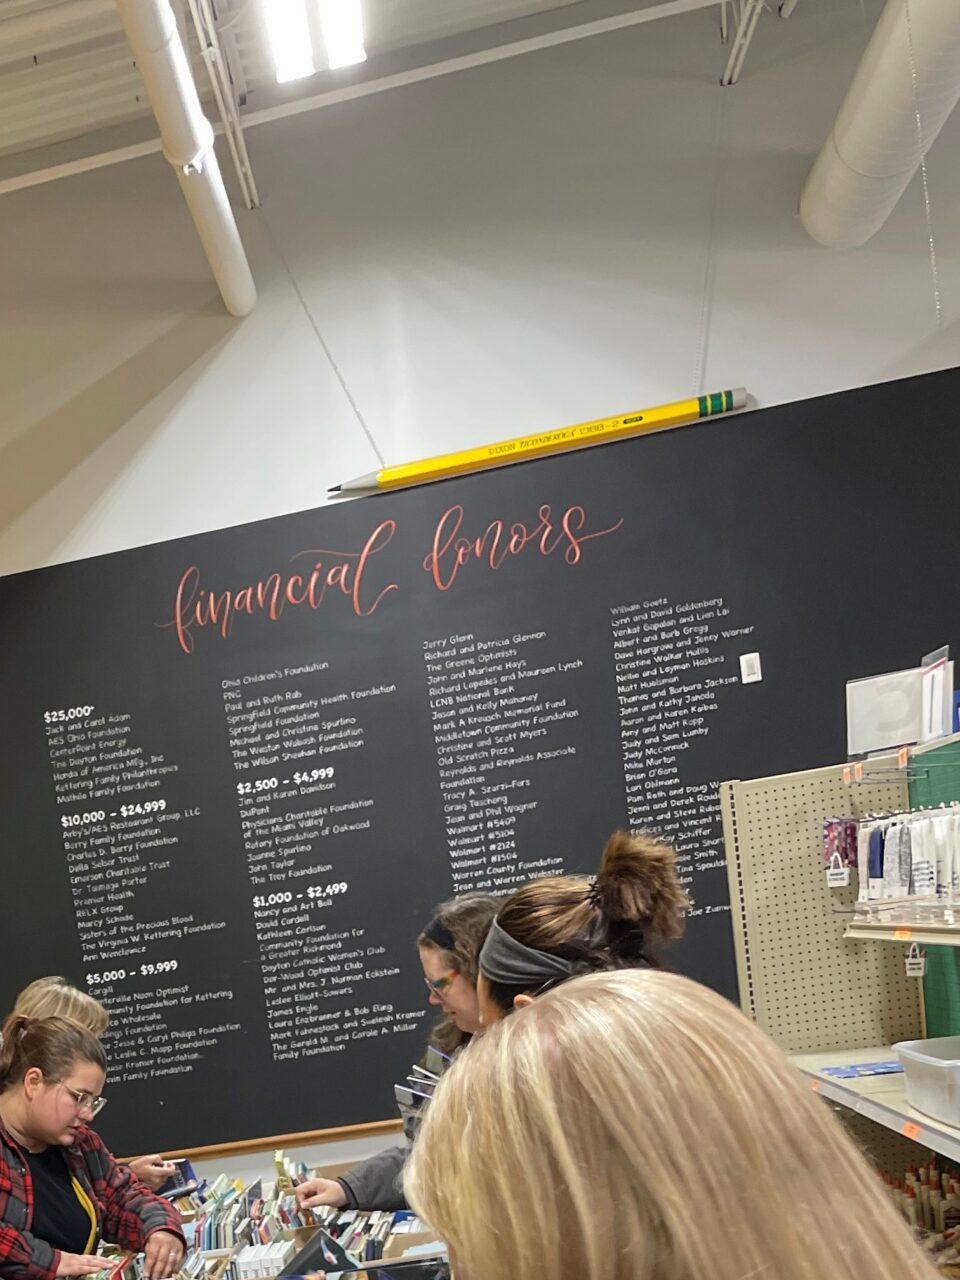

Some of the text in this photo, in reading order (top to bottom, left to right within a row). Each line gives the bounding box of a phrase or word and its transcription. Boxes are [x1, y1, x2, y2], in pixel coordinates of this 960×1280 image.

[154, 504, 624, 653] financial donors
[459, 643, 474, 653] and
[642, 634, 657, 642] and
[221, 662, 328, 688] Ohio Children's Foundation
[223, 689, 241, 699] PNC
[246, 698, 261, 707] and
[455, 689, 490, 702] National
[493, 685, 514, 695] Bank
[617, 676, 737, 704] Thomas and Barbara Jackson
[226, 684, 395, 724] Springfield Community Health Foundation
[48, 726, 130, 745] AES Ohio Foundation
[67, 722, 81, 730] and
[434, 709, 578, 743] Middletown Community Foundation
[50, 747, 142, 768] The Dayton Foundation
[233, 761, 249, 769] The
[318, 739, 363, 754] Foundation
[236, 777, 279, 795] $2,500
[293, 766, 335, 785] $4,999
[61, 810, 105, 828] $10,000
[120, 799, 167, 818] $24,999
[73, 890, 134, 906] Premier Health
[252, 892, 292, 908] $1,000
[307, 882, 348, 899] $2,499
[79, 914, 193, 940] Sisters of the Precious Blood
[86, 969, 126, 985] $5,000
[140, 960, 178, 976] $9,999
[272, 1044, 345, 1060] Family Foundation
